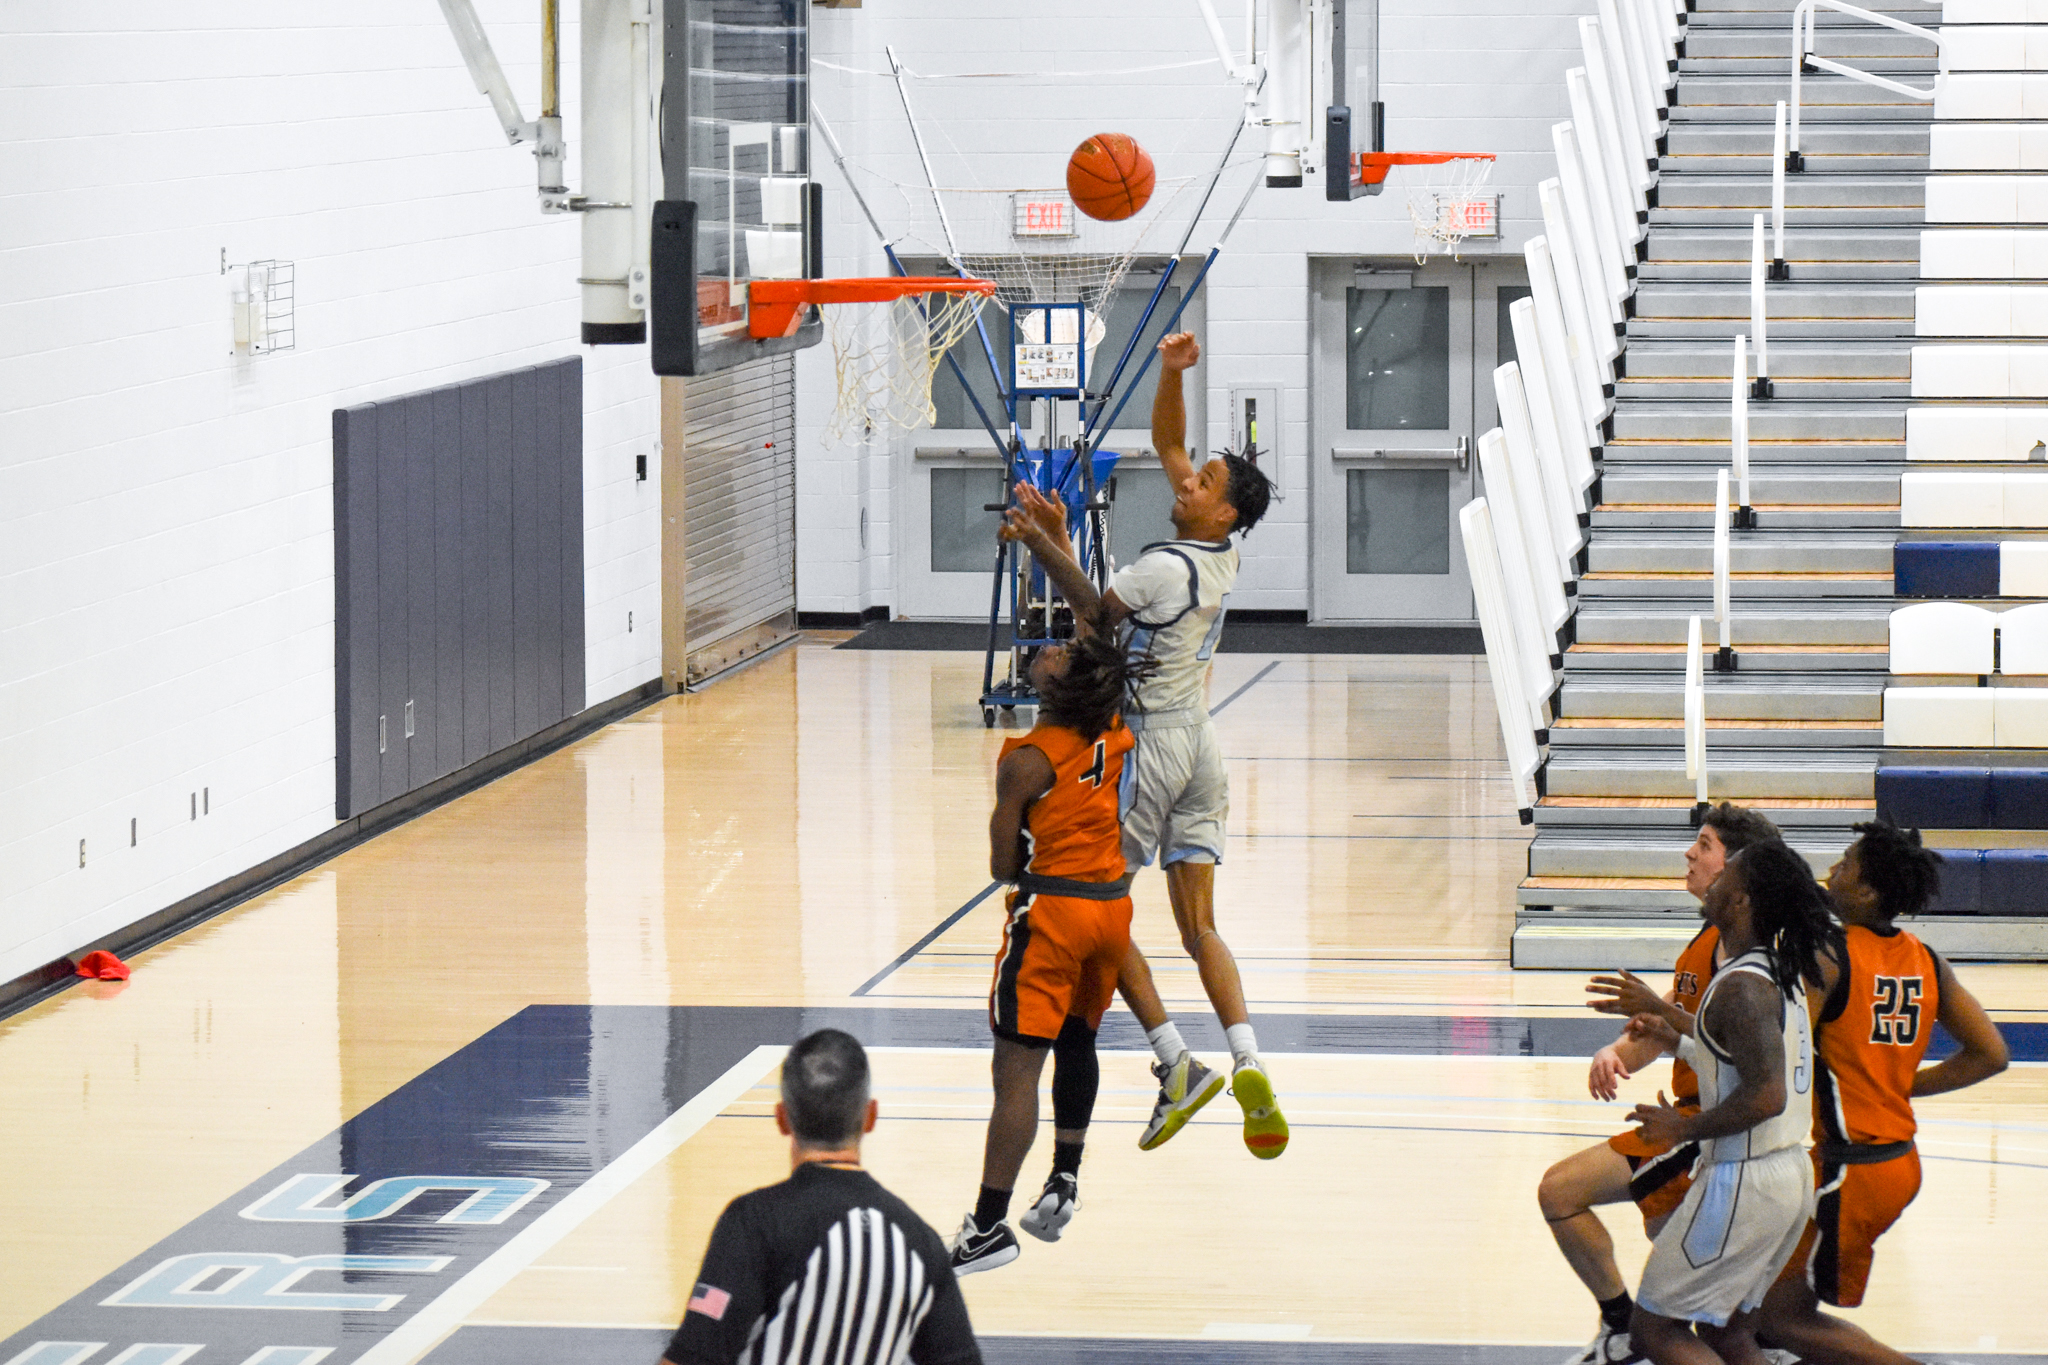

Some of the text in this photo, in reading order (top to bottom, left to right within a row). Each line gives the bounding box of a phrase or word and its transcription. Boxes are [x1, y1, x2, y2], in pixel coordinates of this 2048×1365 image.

[1026, 202, 1063, 230] EXIT
[1078, 739, 1106, 790] 4
[1869, 974, 1924, 1047] 25
[3, 1173, 552, 1365] RS
